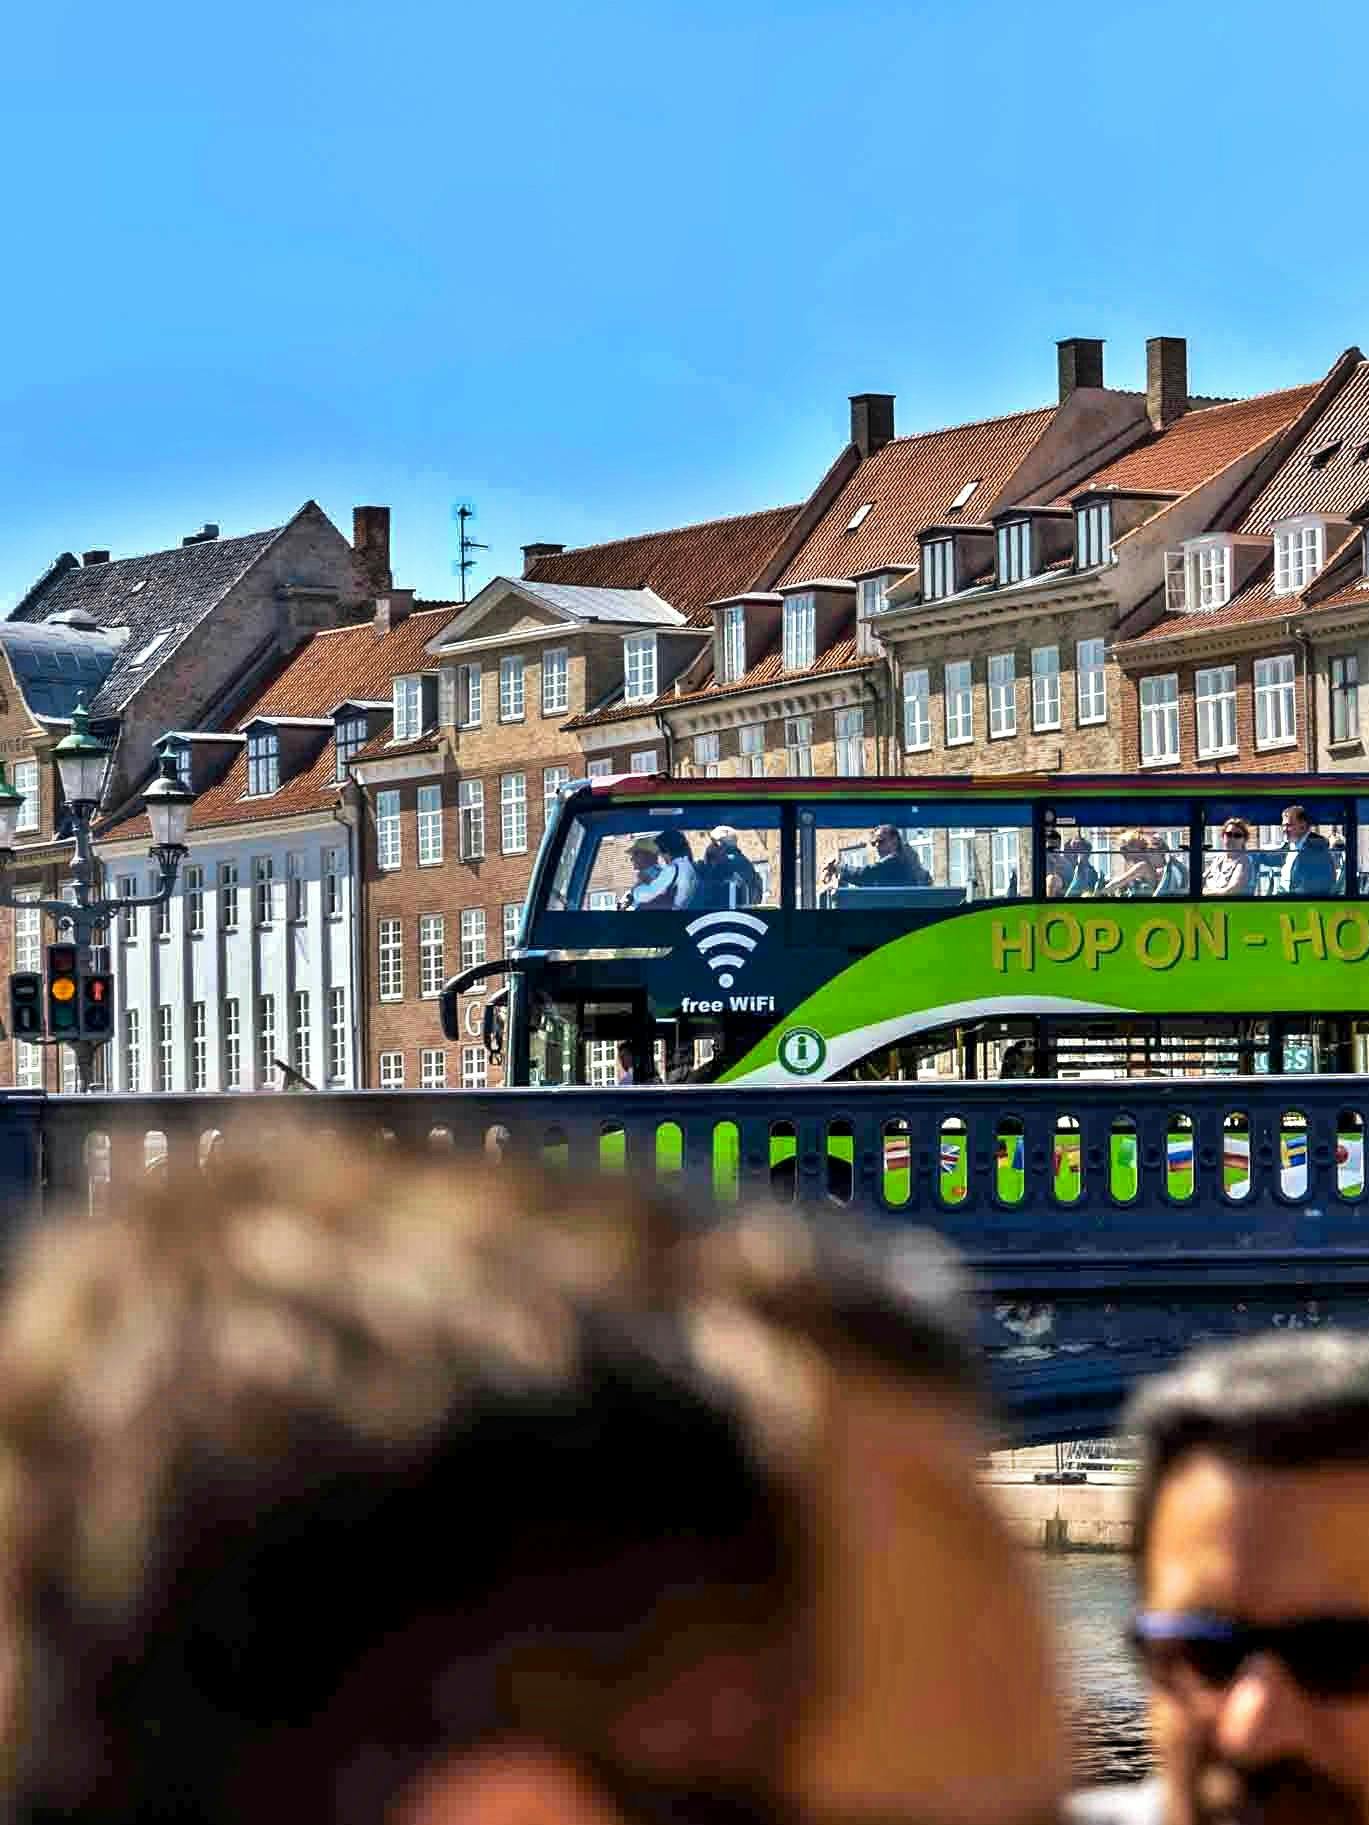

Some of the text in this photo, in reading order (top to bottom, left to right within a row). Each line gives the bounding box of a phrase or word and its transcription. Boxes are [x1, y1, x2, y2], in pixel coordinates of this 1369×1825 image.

[992, 910, 1123, 973] HOP
[1136, 907, 1228, 971] ON
[681, 996, 775, 1012] free WiFi
